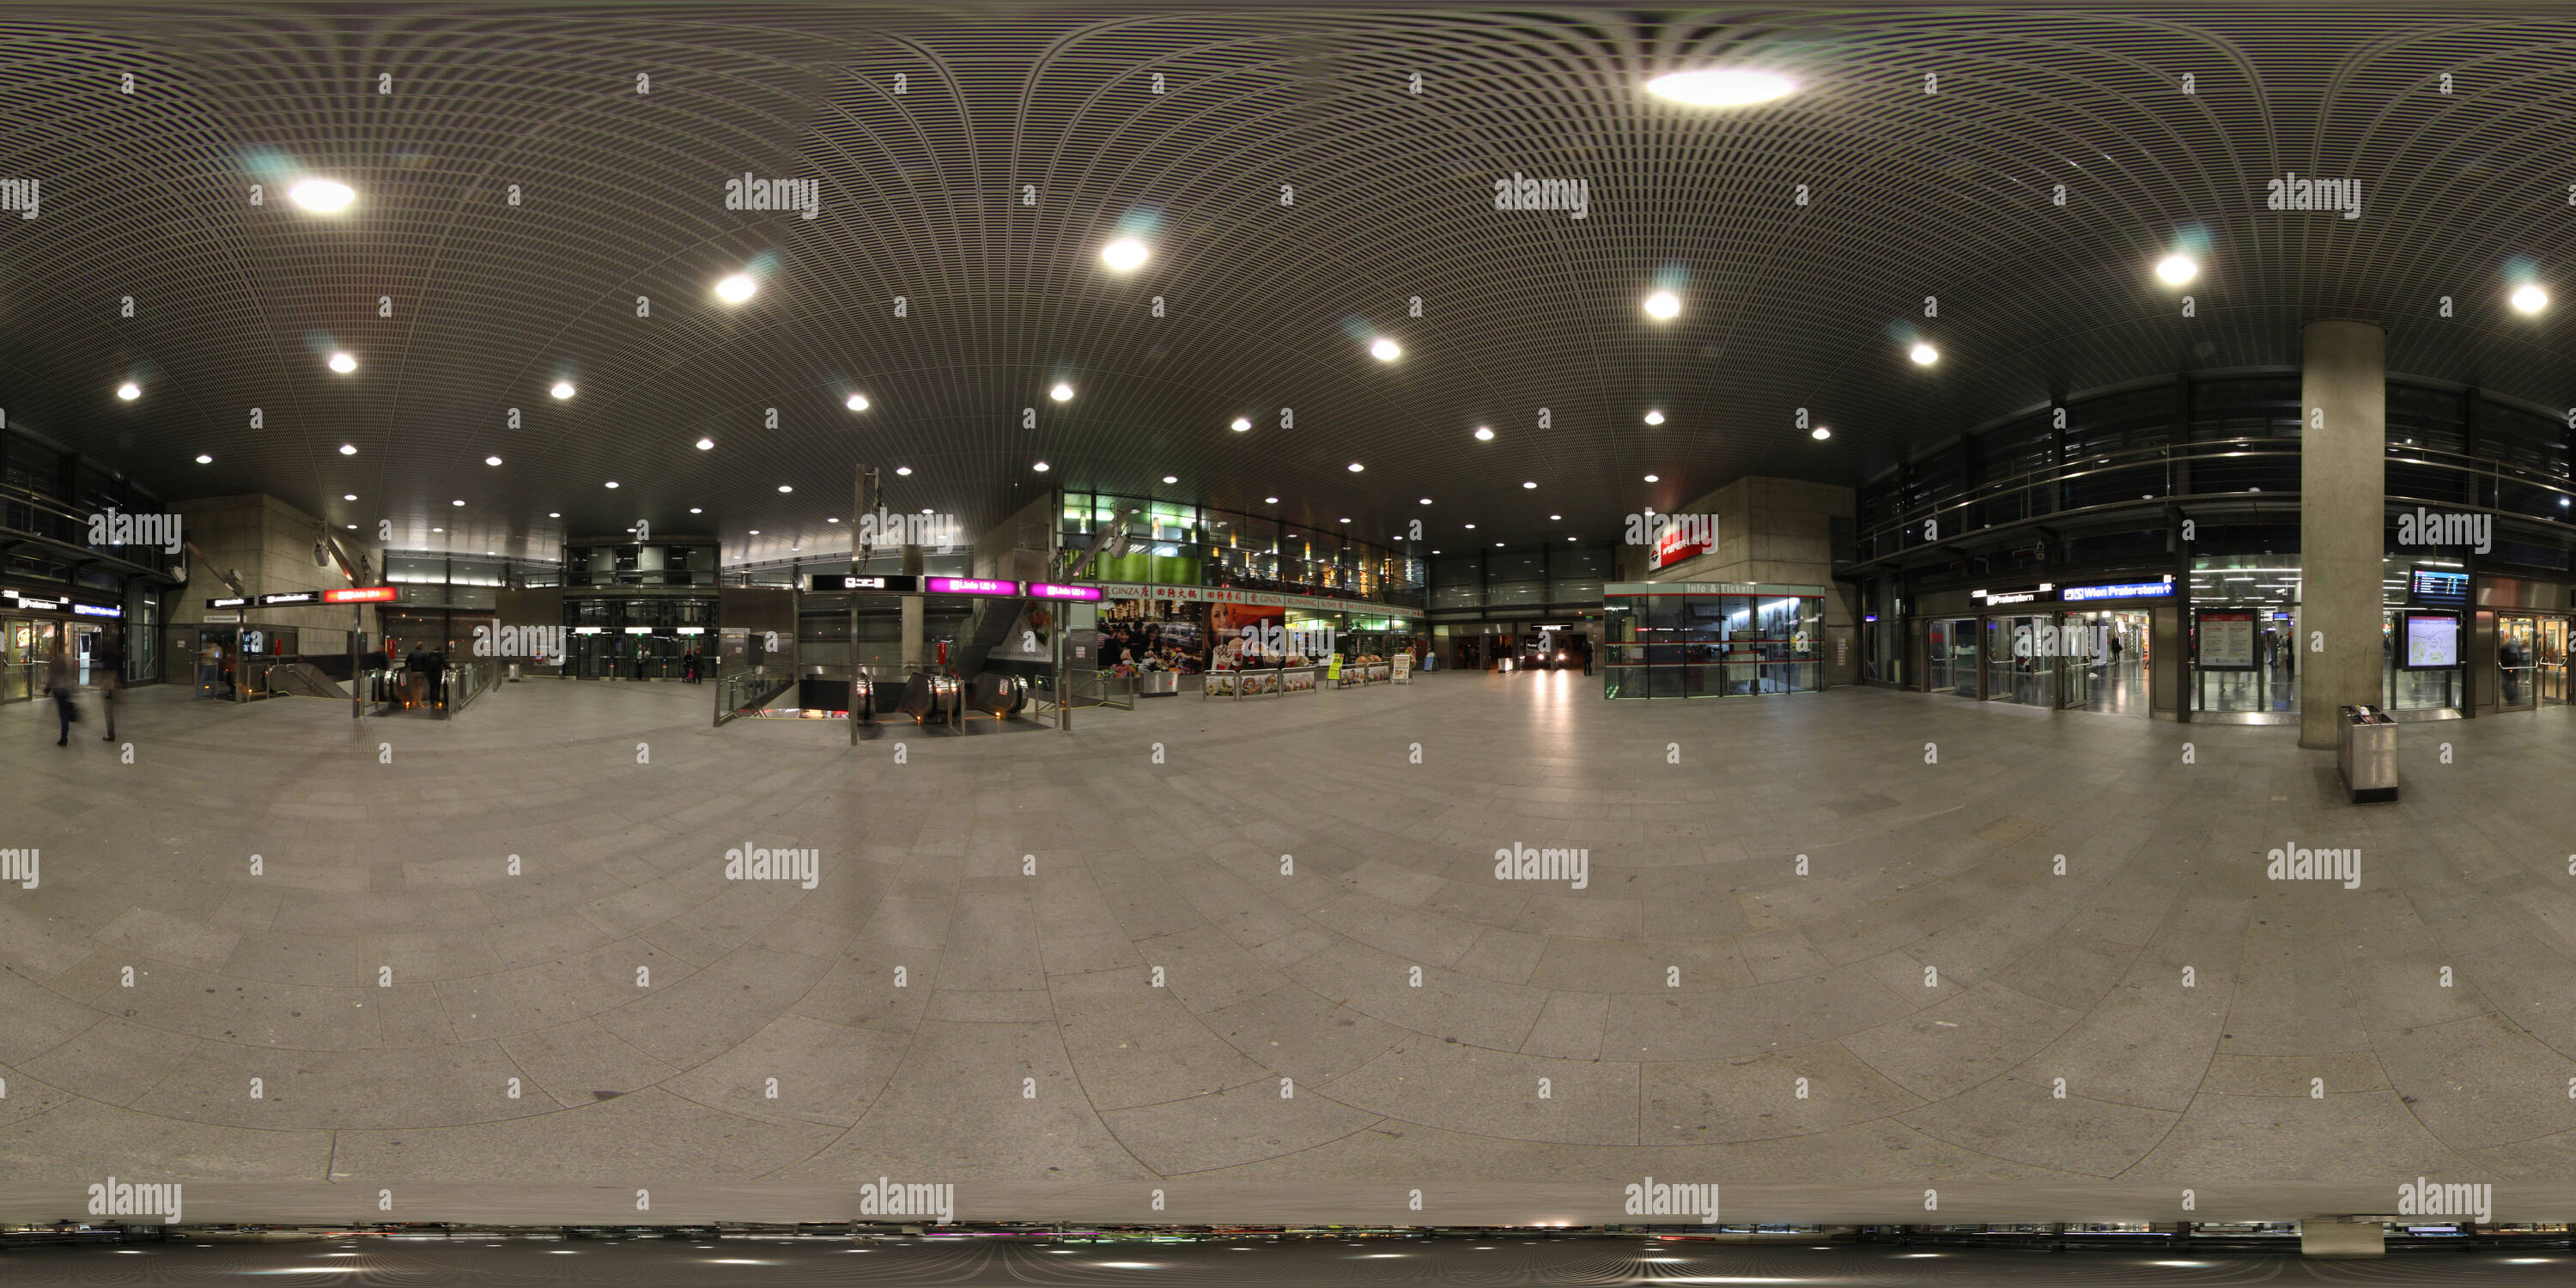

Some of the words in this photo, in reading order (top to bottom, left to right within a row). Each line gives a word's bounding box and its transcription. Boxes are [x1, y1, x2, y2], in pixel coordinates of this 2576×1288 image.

[1687, 584, 1706, 592] Info
[1710, 585, 1716, 593] &
[1720, 584, 1755, 593] Tickets
[2084, 586, 2107, 598] Wien
[2108, 585, 2164, 596] Praterstern
[1260, 595, 1281, 604] GINZA
[1287, 597, 1317, 607] RUNNING
